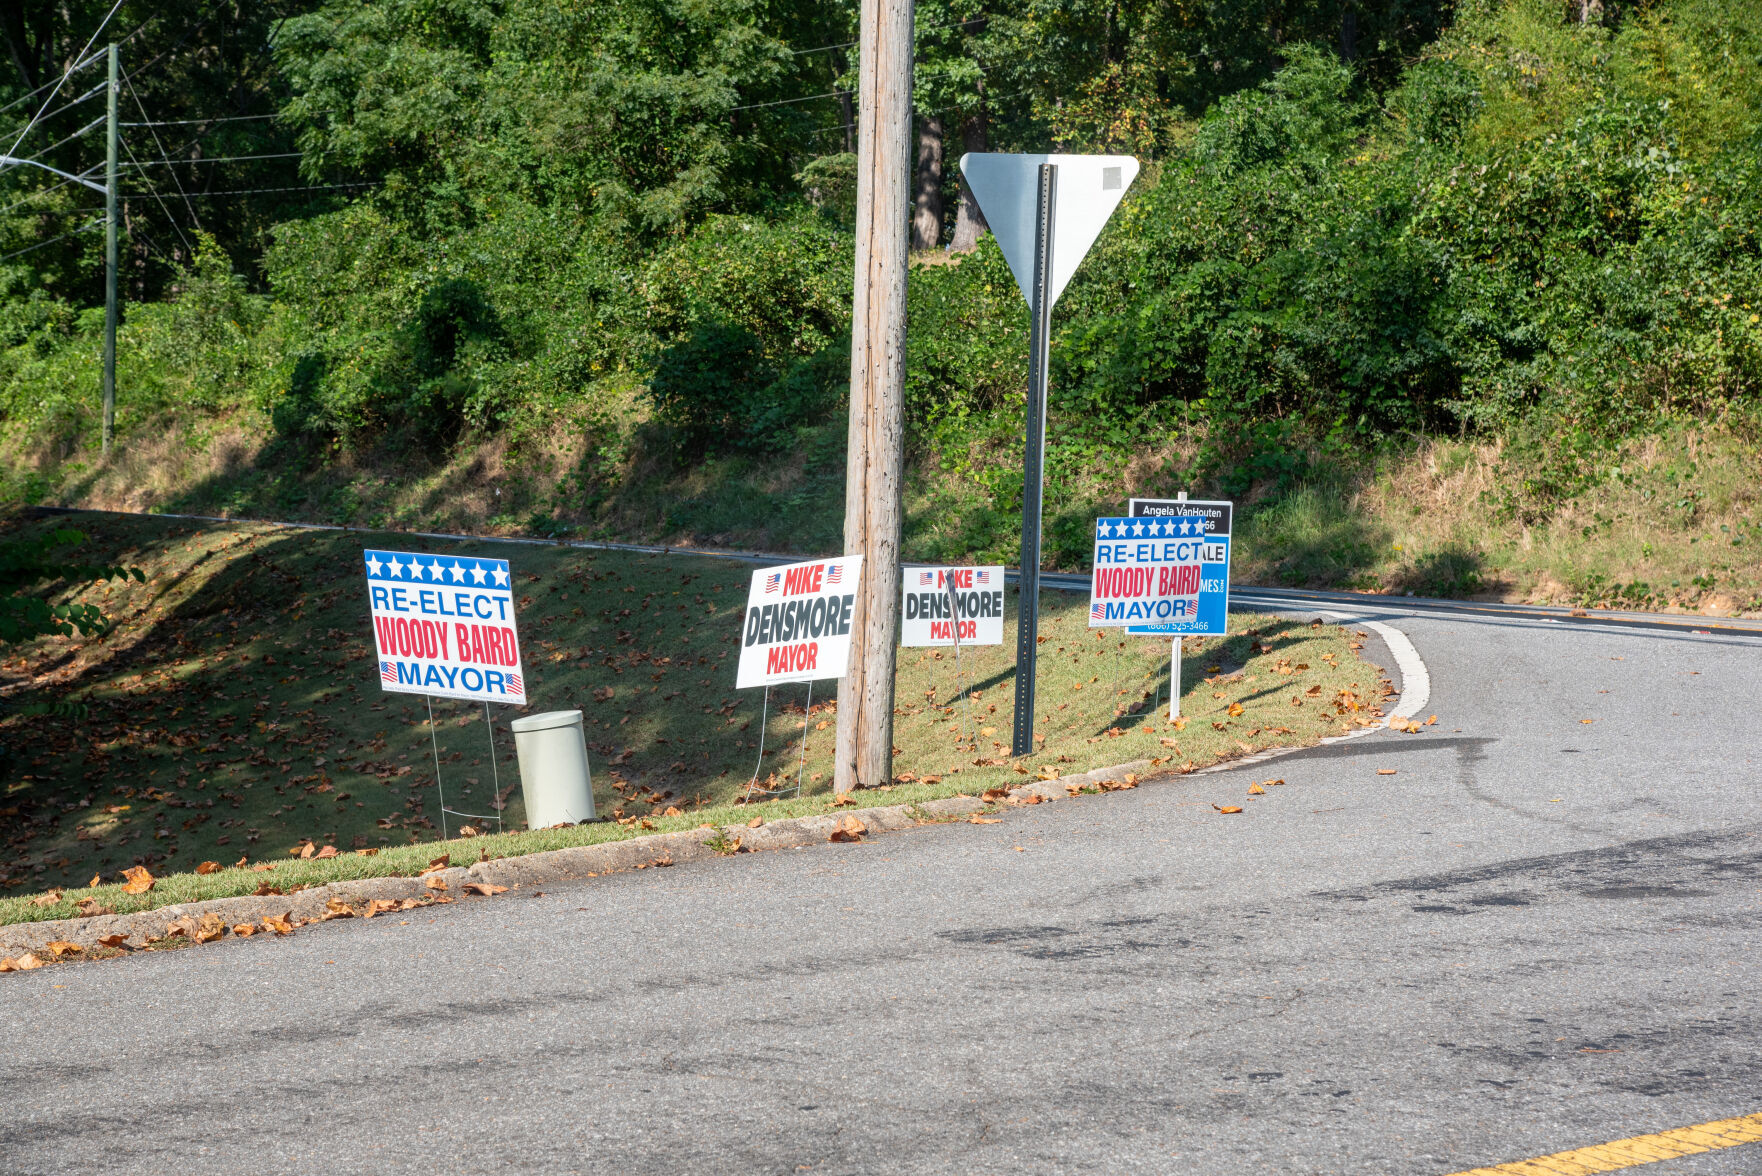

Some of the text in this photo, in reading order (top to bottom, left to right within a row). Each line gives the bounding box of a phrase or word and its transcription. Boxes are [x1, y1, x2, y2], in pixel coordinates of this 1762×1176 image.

[1142, 505, 1222, 518] Angela VanHouten
[1097, 542, 1202, 563] RE-ELECT
[783, 564, 824, 596] MIKE
[938, 570, 973, 589] MKE
[1096, 565, 1200, 598] WOODY BAIRD
[372, 586, 509, 620] RE-ELECT
[906, 591, 1002, 619] DENSMORE
[1105, 600, 1187, 619] MAYOR
[745, 594, 854, 647] DENSMORE
[374, 616, 517, 667] WOODY BAIRD
[767, 642, 818, 675] MAYOR
[396, 662, 507, 694] MAYOR
